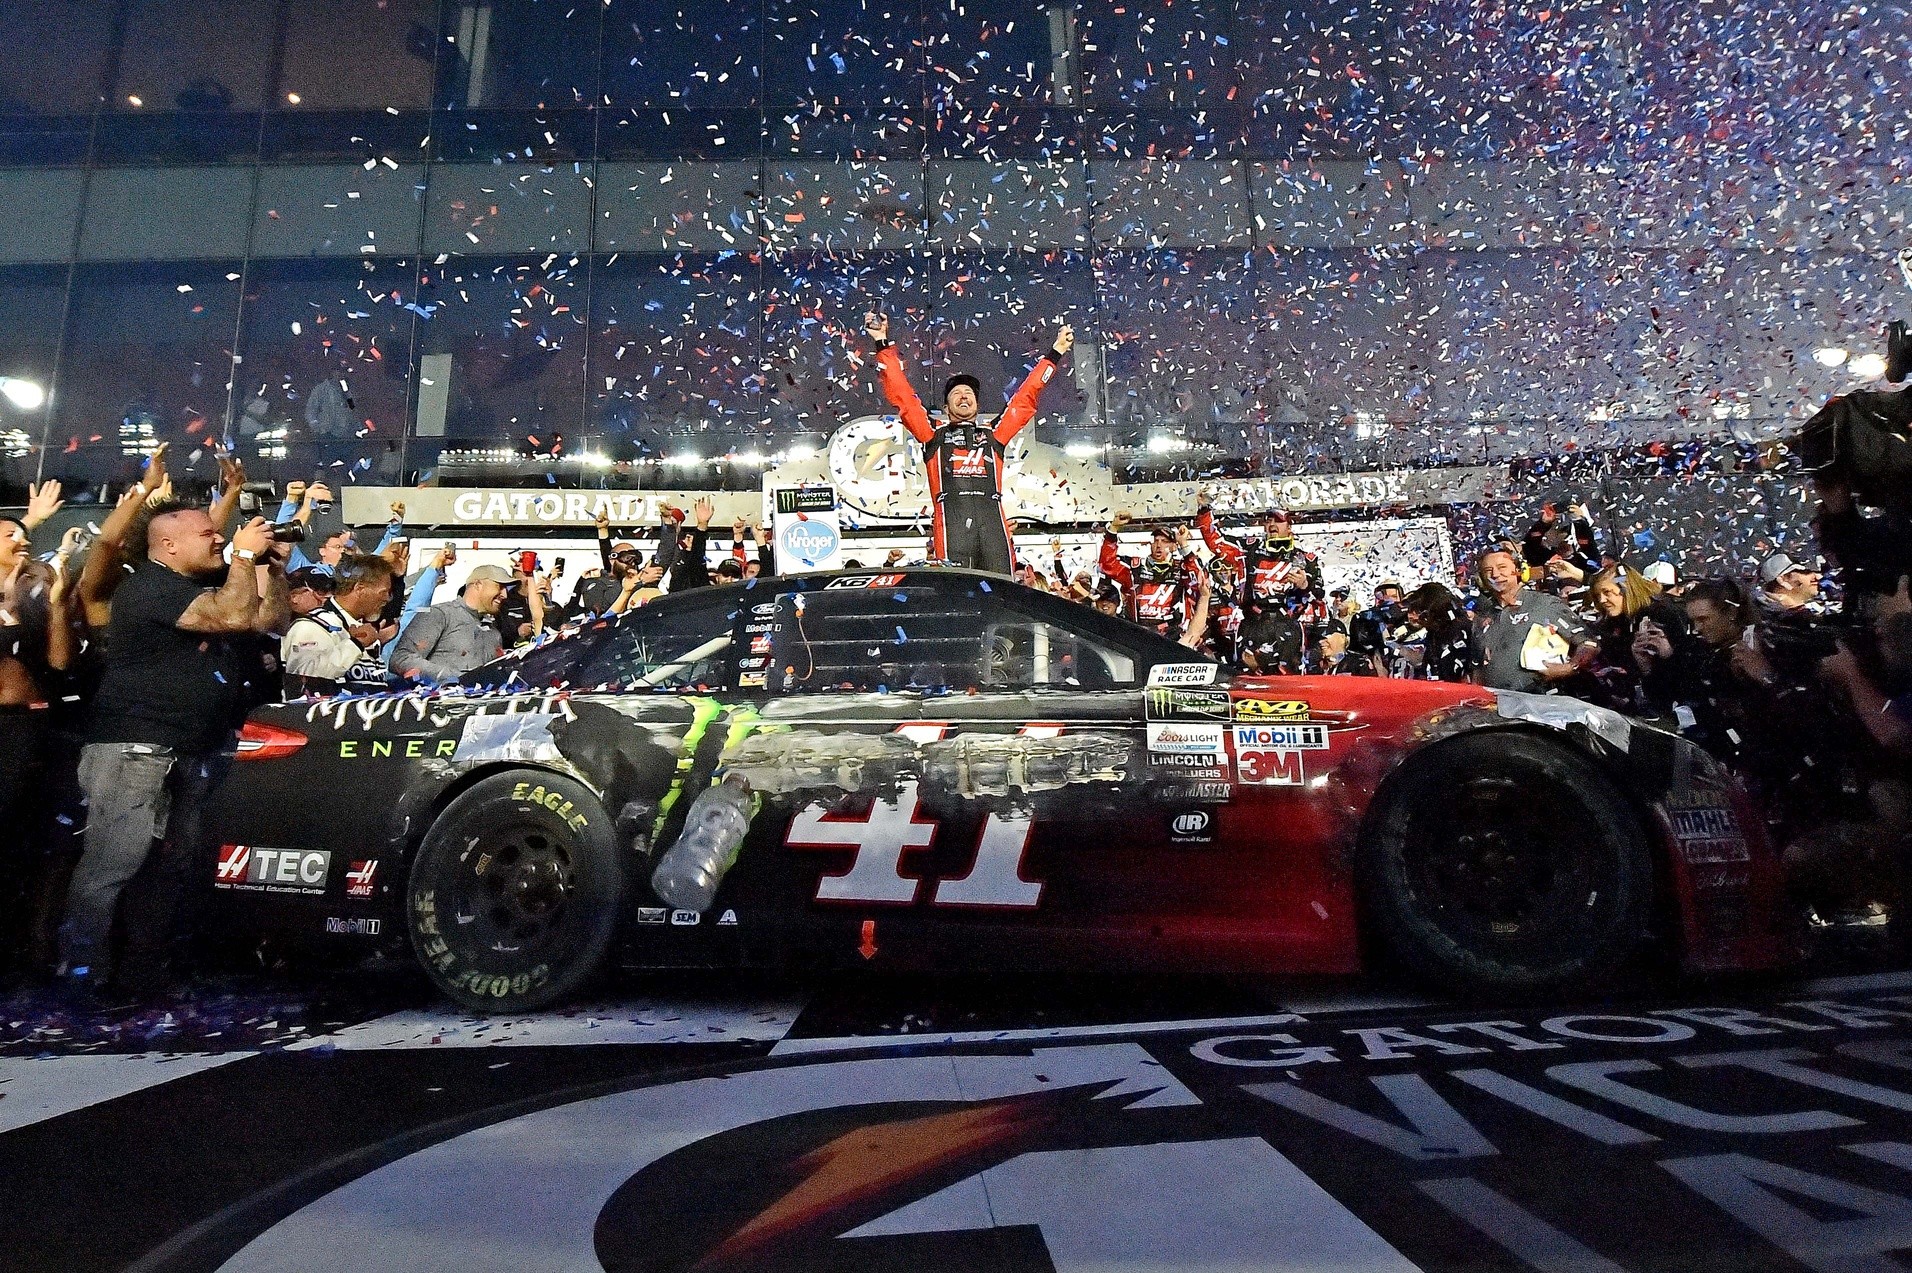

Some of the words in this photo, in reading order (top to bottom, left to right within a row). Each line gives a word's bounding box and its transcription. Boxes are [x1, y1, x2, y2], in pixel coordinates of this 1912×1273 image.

[953, 466, 985, 474] HAAS
[453, 492, 670, 521] GATORADE
[788, 527, 833, 557] Kroger
[876, 575, 895, 586] 41
[1170, 666, 1208, 674] NASCAR
[1157, 675, 1183, 683] RACE
[1157, 730, 1188, 742] Coors
[1238, 727, 1297, 743] Mobil
[1151, 755, 1214, 767] LINCOLN
[1240, 751, 1302, 783] 3M
[511, 782, 588, 833] EAGLE
[1178, 814, 1202, 830] IR
[233, 883, 264, 891] Technical
[266, 885, 300, 894] Education
[302, 887, 325, 895] Center
[675, 912, 697, 923] SEM
[326, 917, 365, 934] Mobil
